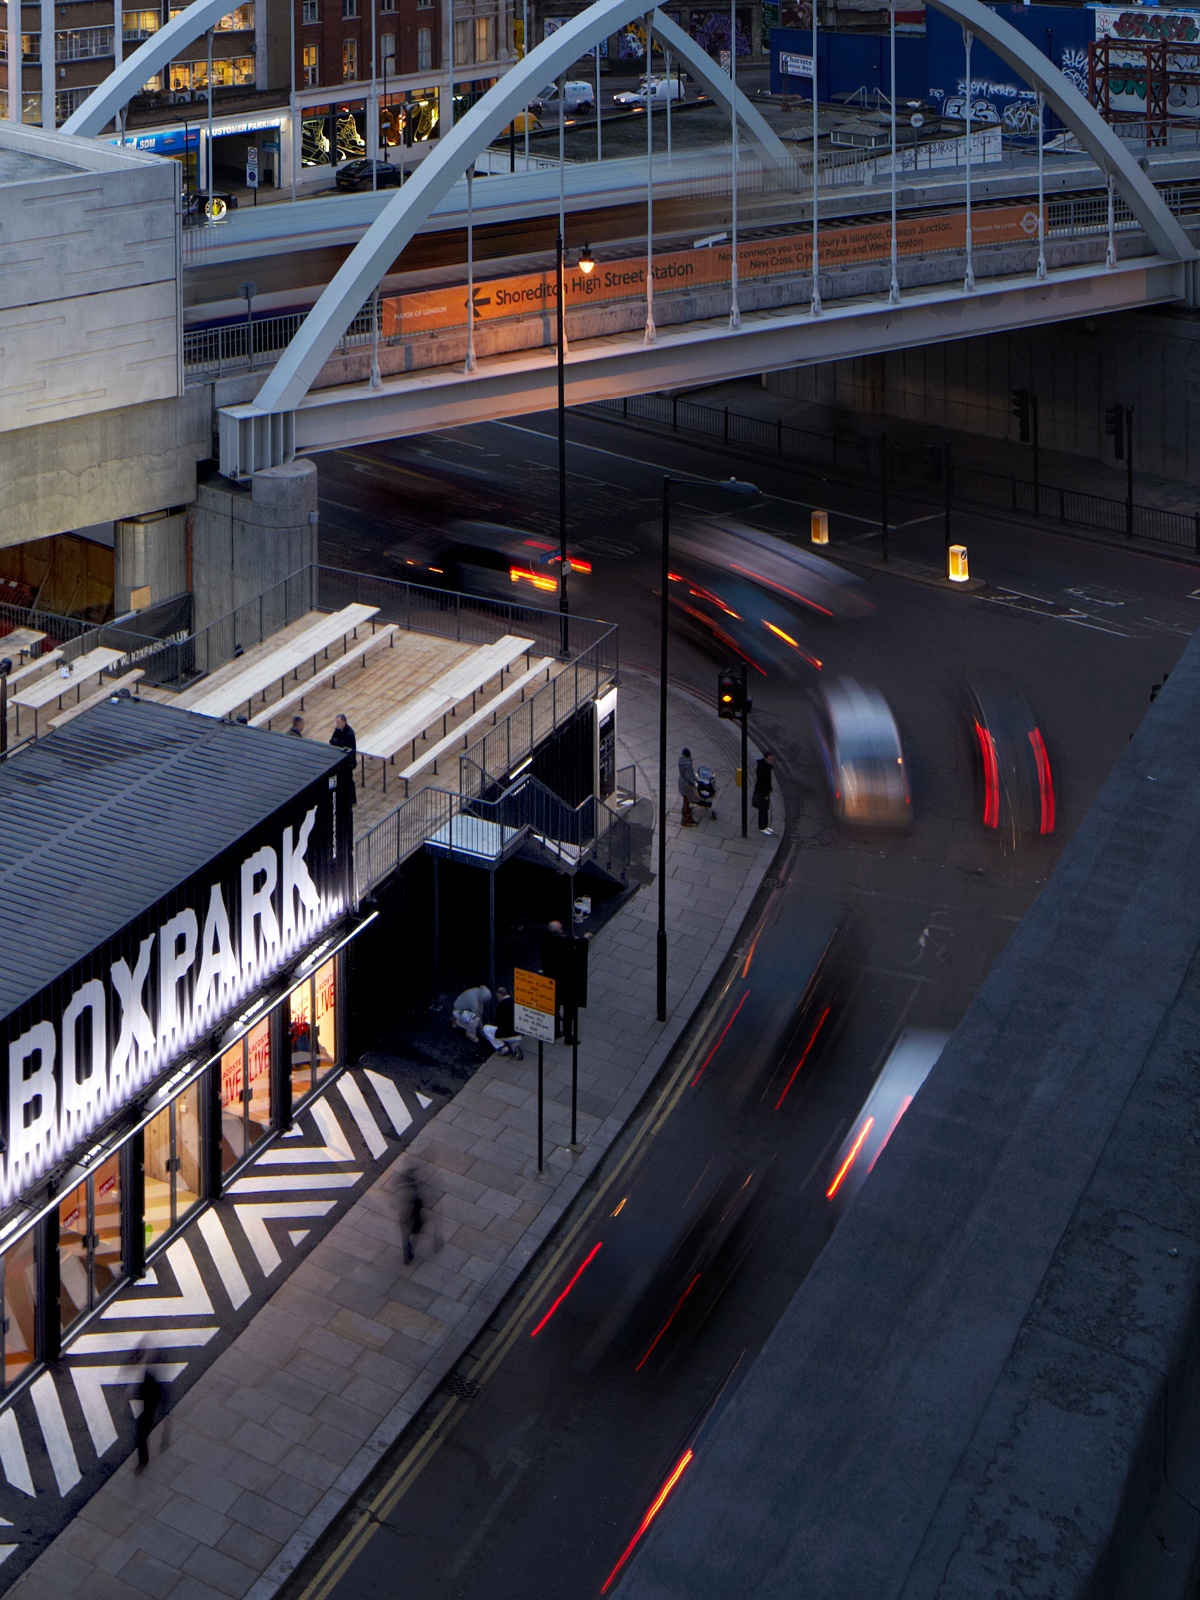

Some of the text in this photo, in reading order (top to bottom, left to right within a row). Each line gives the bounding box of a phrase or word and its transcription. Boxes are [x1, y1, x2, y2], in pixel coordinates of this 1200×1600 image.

[248, 118, 280, 130] PARKING
[718, 252, 734, 261] No
[739, 247, 776, 258] connects
[778, 245, 792, 255] you
[794, 242, 803, 250] to
[805, 238, 839, 249] Hhbury
[842, 235, 847, 244] &
[887, 228, 916, 238] Dlston
[750, 259, 768, 268] New
[797, 250, 824, 263] Crysal
[826, 248, 850, 258] Palace
[852, 245, 866, 254] and
[869, 241, 888, 251] West
[890, 238, 923, 249] roydon
[572, 275, 601, 294] High
[605, 269, 645, 287] Street
[650, 262, 694, 280] Station
[394, 311, 413, 320] MAYOR
[423, 306, 448, 315] LONDON
[9, 805, 320, 1165] BOXPARK
[222, 1058, 242, 1079] ACOSTE
